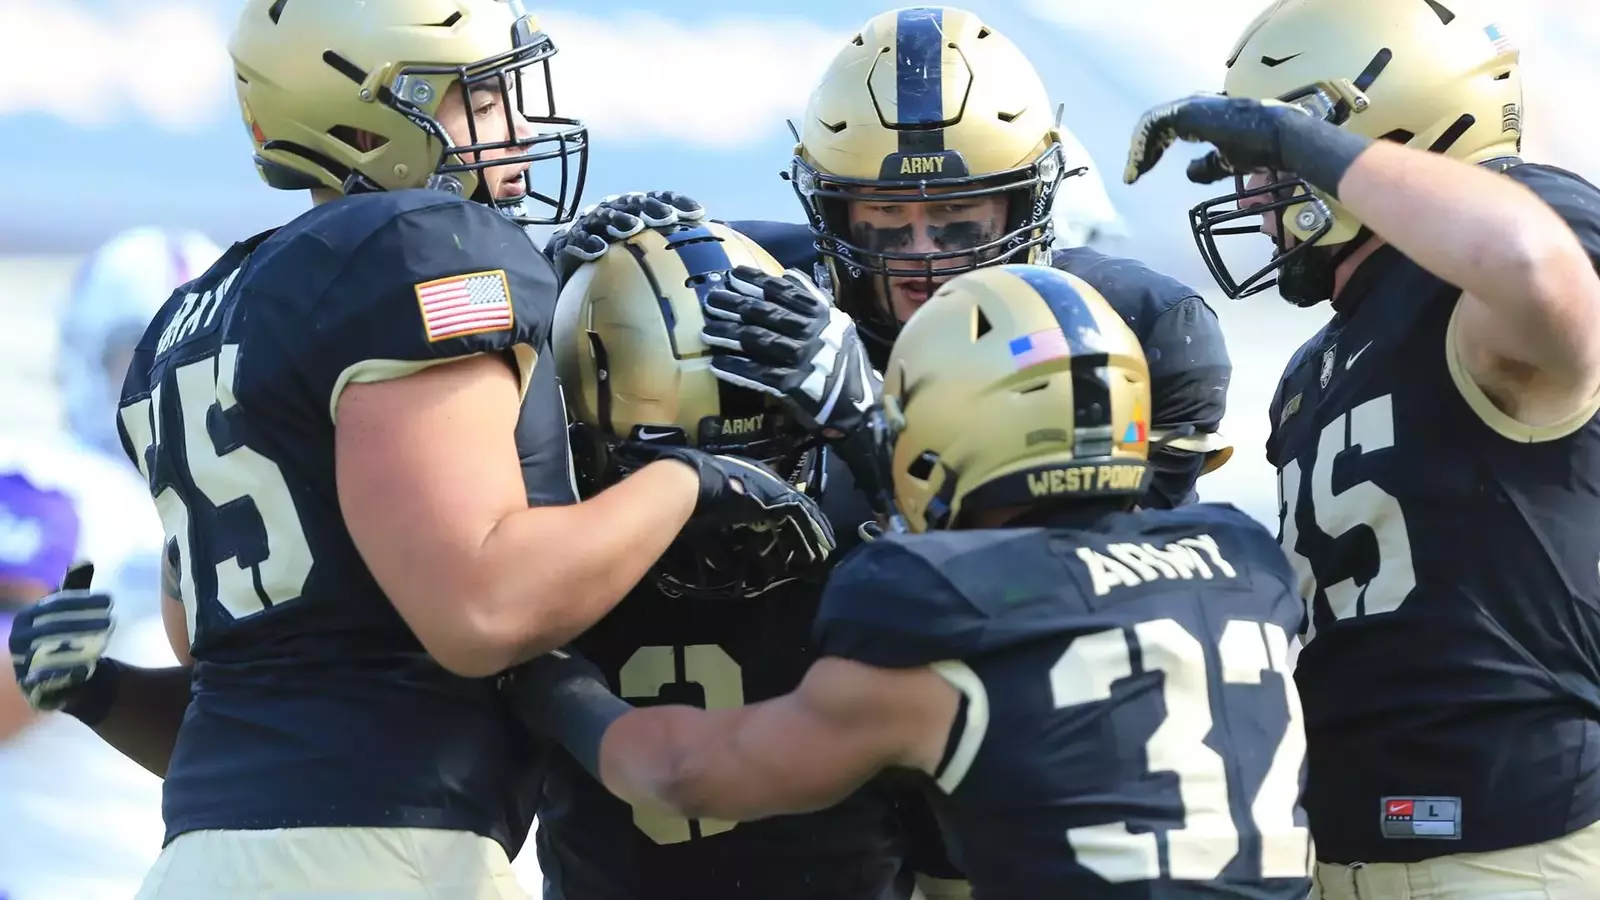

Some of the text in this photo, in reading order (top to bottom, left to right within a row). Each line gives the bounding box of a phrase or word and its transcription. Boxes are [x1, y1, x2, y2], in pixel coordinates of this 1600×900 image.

[900, 156, 945, 174] ARMY
[722, 413, 764, 435] ARMY
[1027, 465, 1147, 497] WEST POINT
[1076, 534, 1238, 596] ARMY
[1049, 617, 1316, 884] 32
[1428, 804, 1439, 817] L
